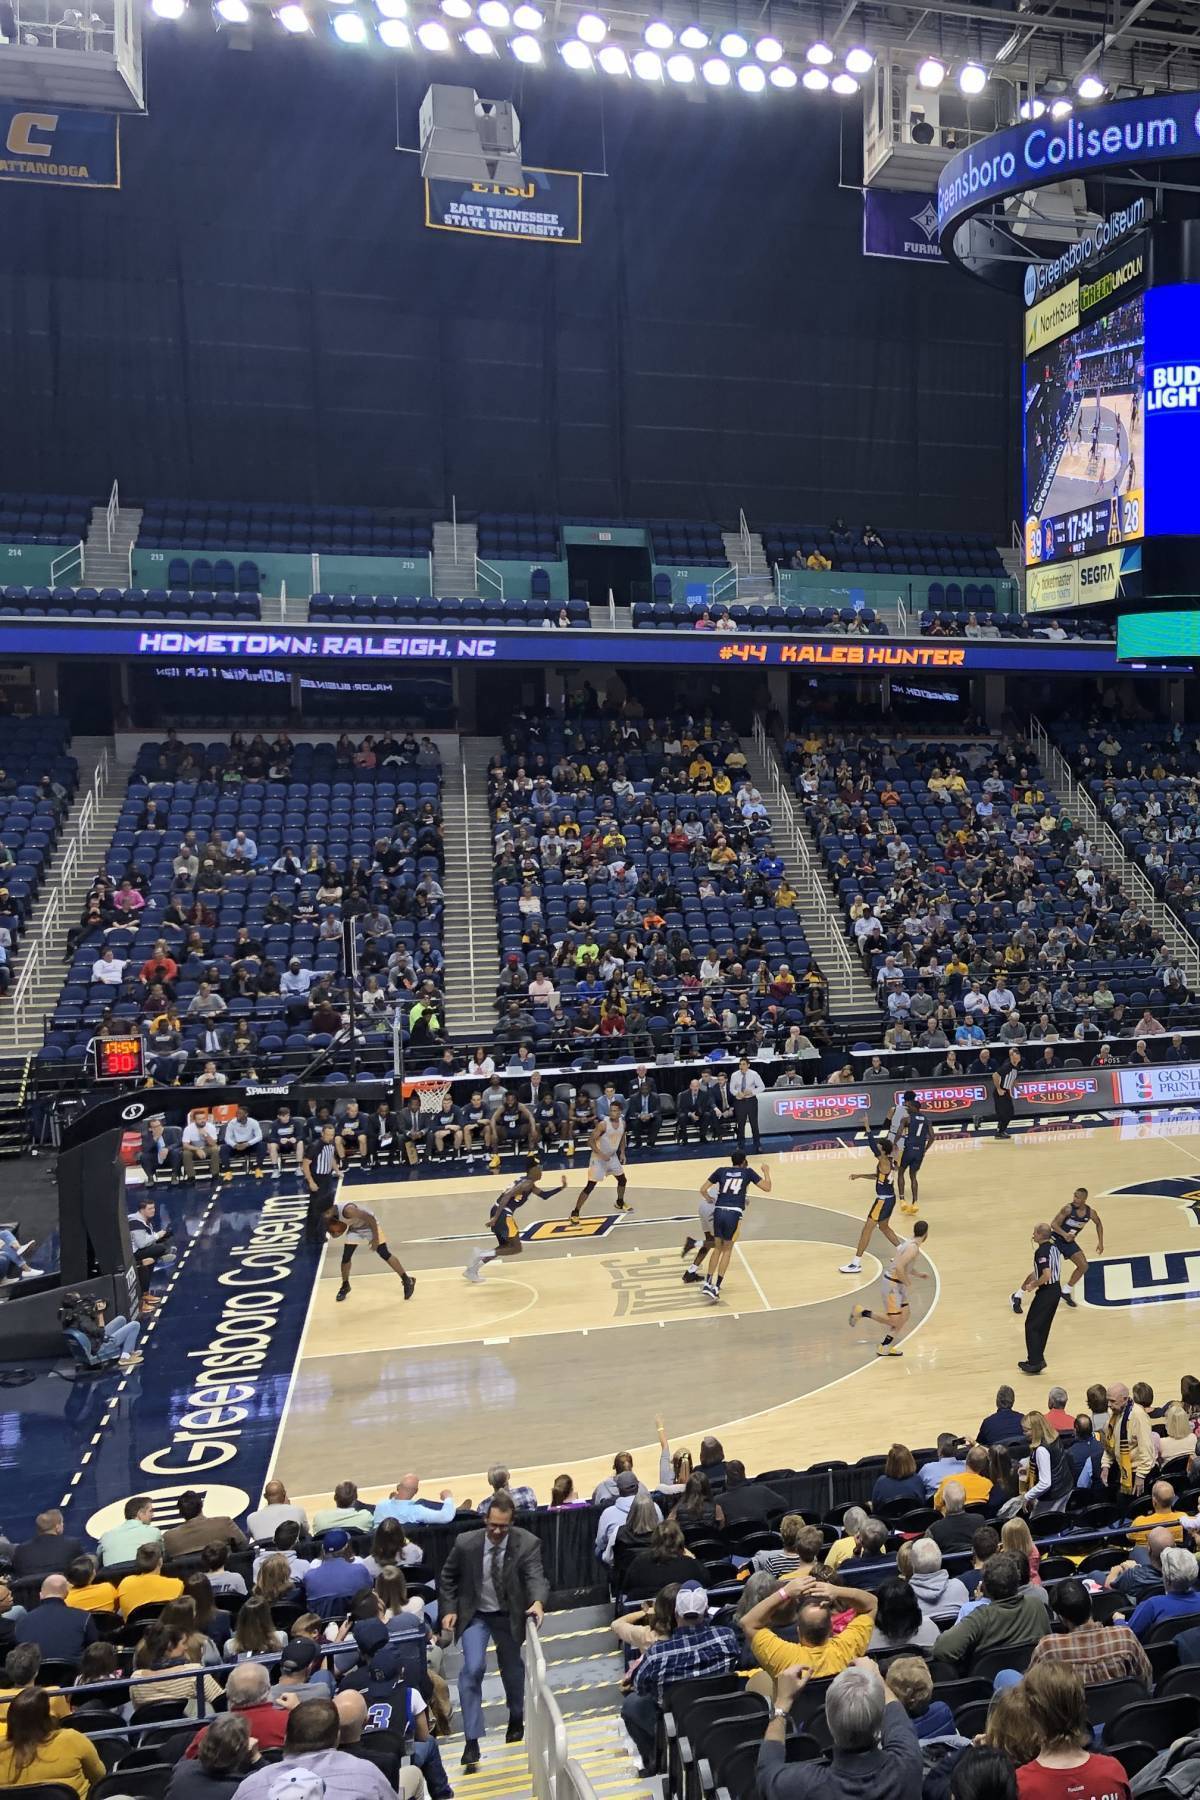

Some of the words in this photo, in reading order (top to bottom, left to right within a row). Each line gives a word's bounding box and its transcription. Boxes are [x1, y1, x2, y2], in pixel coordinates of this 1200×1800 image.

[7, 112, 59, 157] C
[1024, 118, 1177, 169] Coliseum
[0, 160, 89, 178] ATTANOOGA
[450, 202, 483, 217] EAST
[486, 207, 559, 225] TENNESSEE
[444, 214, 487, 229] STATE
[489, 220, 565, 237] UNIVERSITY
[1037, 237, 1092, 289] Greensboro
[1094, 198, 1145, 249] Coliseum
[1080, 272, 1113, 311] GREEN
[1112, 256, 1143, 289] LINCOLN
[1040, 298, 1080, 334] NorthState
[1067, 511, 1093, 542] 17:54
[1124, 499, 1139, 534] 28
[8, 549, 22, 557] 214
[1030, 528, 1041, 558] 39
[402, 561, 415, 569] 213
[676, 570, 689, 578] 212
[1080, 563, 1115, 586] SEGRA
[139, 632, 319, 654] HOMETOWN:
[322, 637, 451, 657] RALEIGH,
[457, 639, 496, 657] NC
[719, 644, 767, 661] #44
[781, 646, 864, 663] KALEB
[867, 648, 966, 666] HUNTER
[104, 1040, 138, 1054] 17:54
[109, 1054, 132, 1072] 30
[245, 1085, 289, 1097] SPALDING
[1040, 1092, 1071, 1104] SUBS
[776, 1095, 868, 1116] FIREHOUSE
[806, 1107, 841, 1119] SUBS
[925, 1098, 958, 1111] SUBS
[916, 1123, 924, 1137] 1
[722, 1178, 743, 1195] 14
[139, 1290, 285, 1476] Greensboro
[218, 1194, 311, 1286] Coliseum
